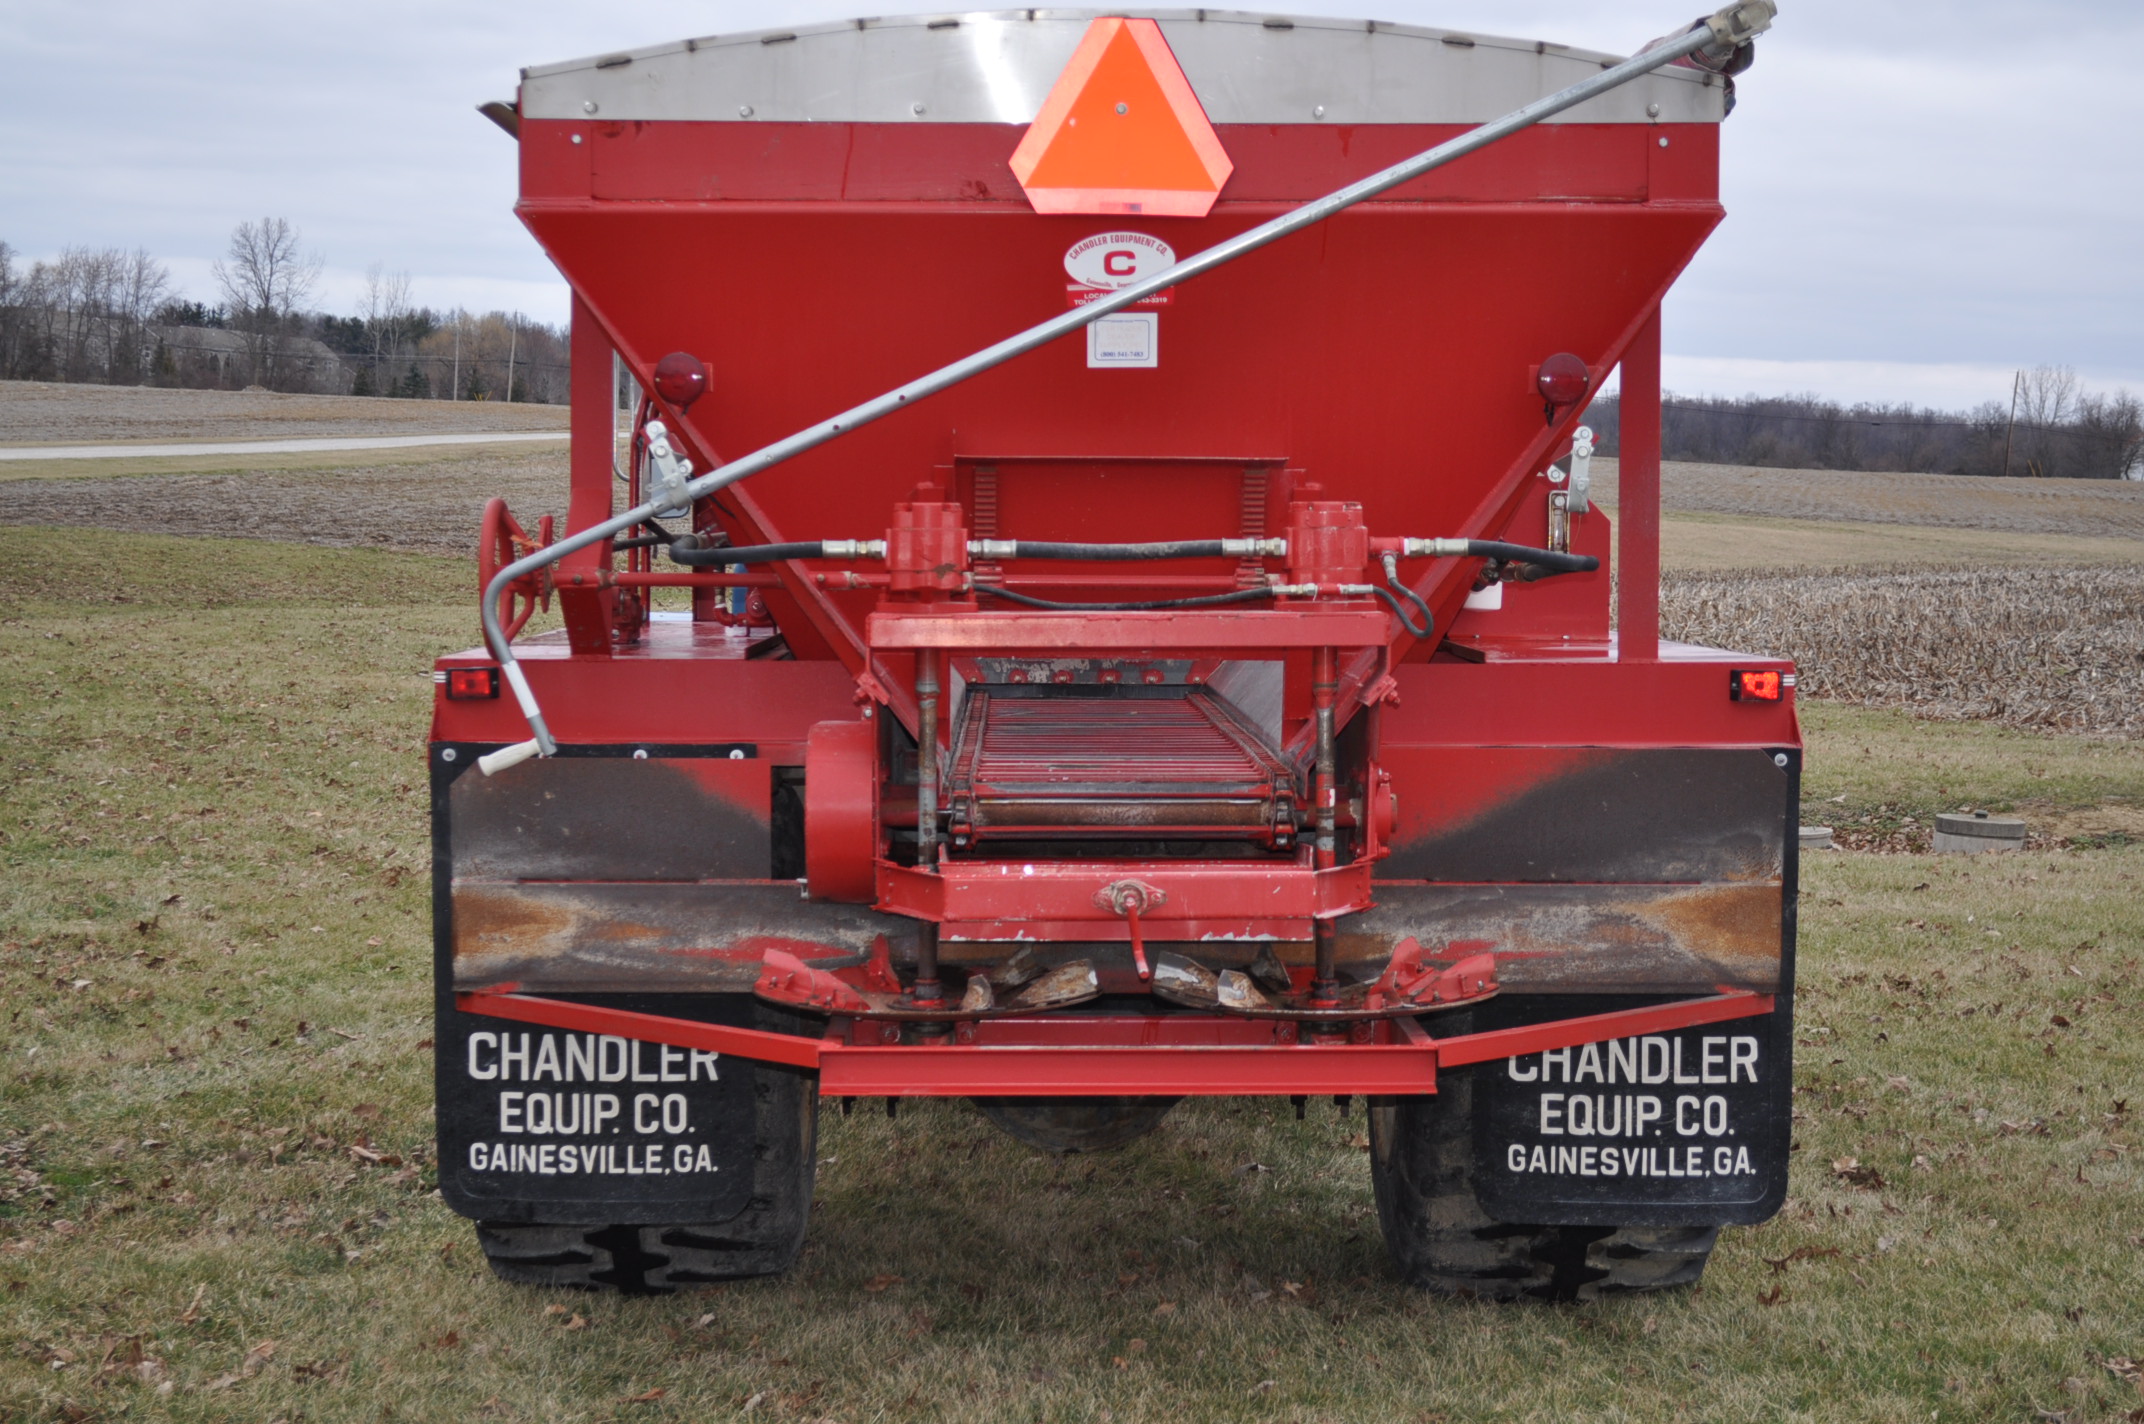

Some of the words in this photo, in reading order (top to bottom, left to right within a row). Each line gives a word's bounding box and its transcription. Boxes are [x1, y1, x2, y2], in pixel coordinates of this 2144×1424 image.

[1069, 235, 1108, 260] CHANDLER
[1110, 234, 1156, 248] EQUIPMENT
[1155, 243, 1168, 257] CO.
[1104, 250, 1136, 276] C
[468, 1031, 719, 1082] CHANDLER
[1508, 1036, 1759, 1085] CHANDLER
[499, 1091, 620, 1135] EQUIP.
[634, 1092, 696, 1135] CO.
[1540, 1092, 1662, 1138] EQUIP.
[1675, 1094, 1735, 1137] CO.
